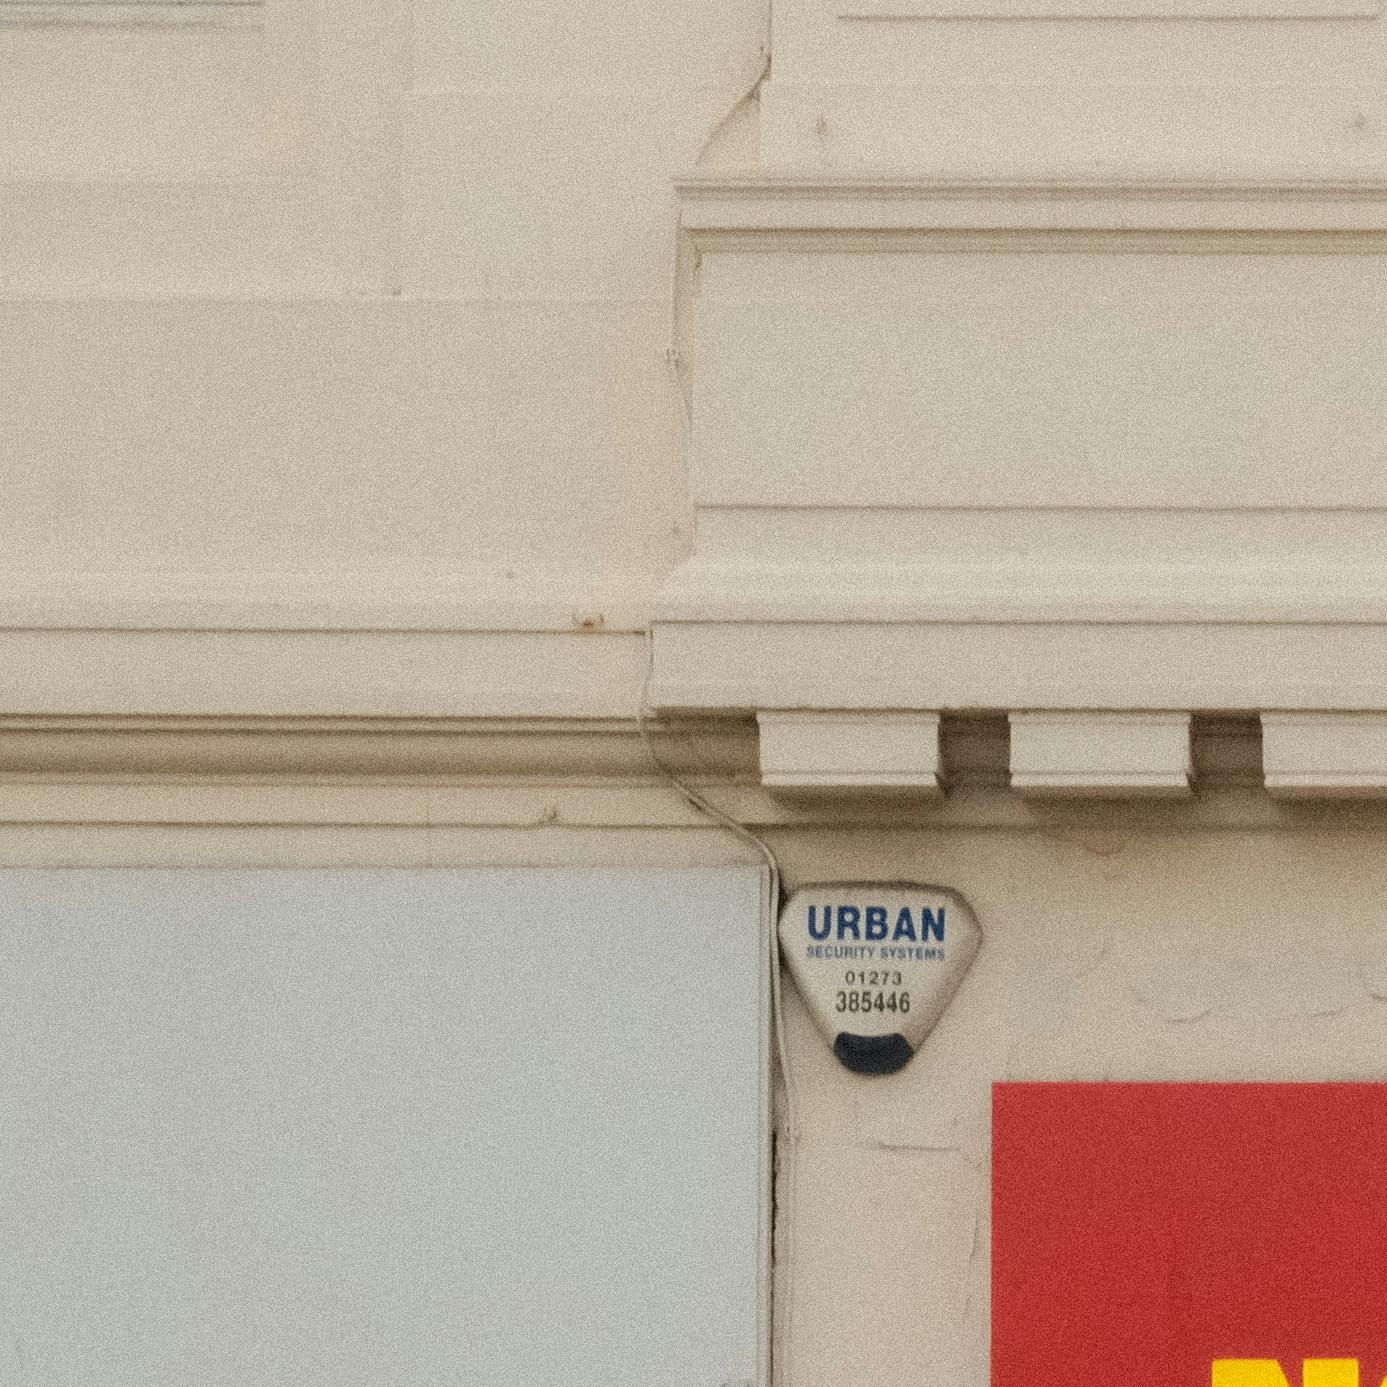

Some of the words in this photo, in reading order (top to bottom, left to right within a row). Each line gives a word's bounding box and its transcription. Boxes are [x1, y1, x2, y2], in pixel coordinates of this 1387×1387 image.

[808, 905, 946, 942] URBAN
[807, 945, 874, 959] SECURITY
[879, 945, 946, 961] SYSTEMS
[844, 970, 903, 986] 01273
[835, 990, 911, 1013] 385446
